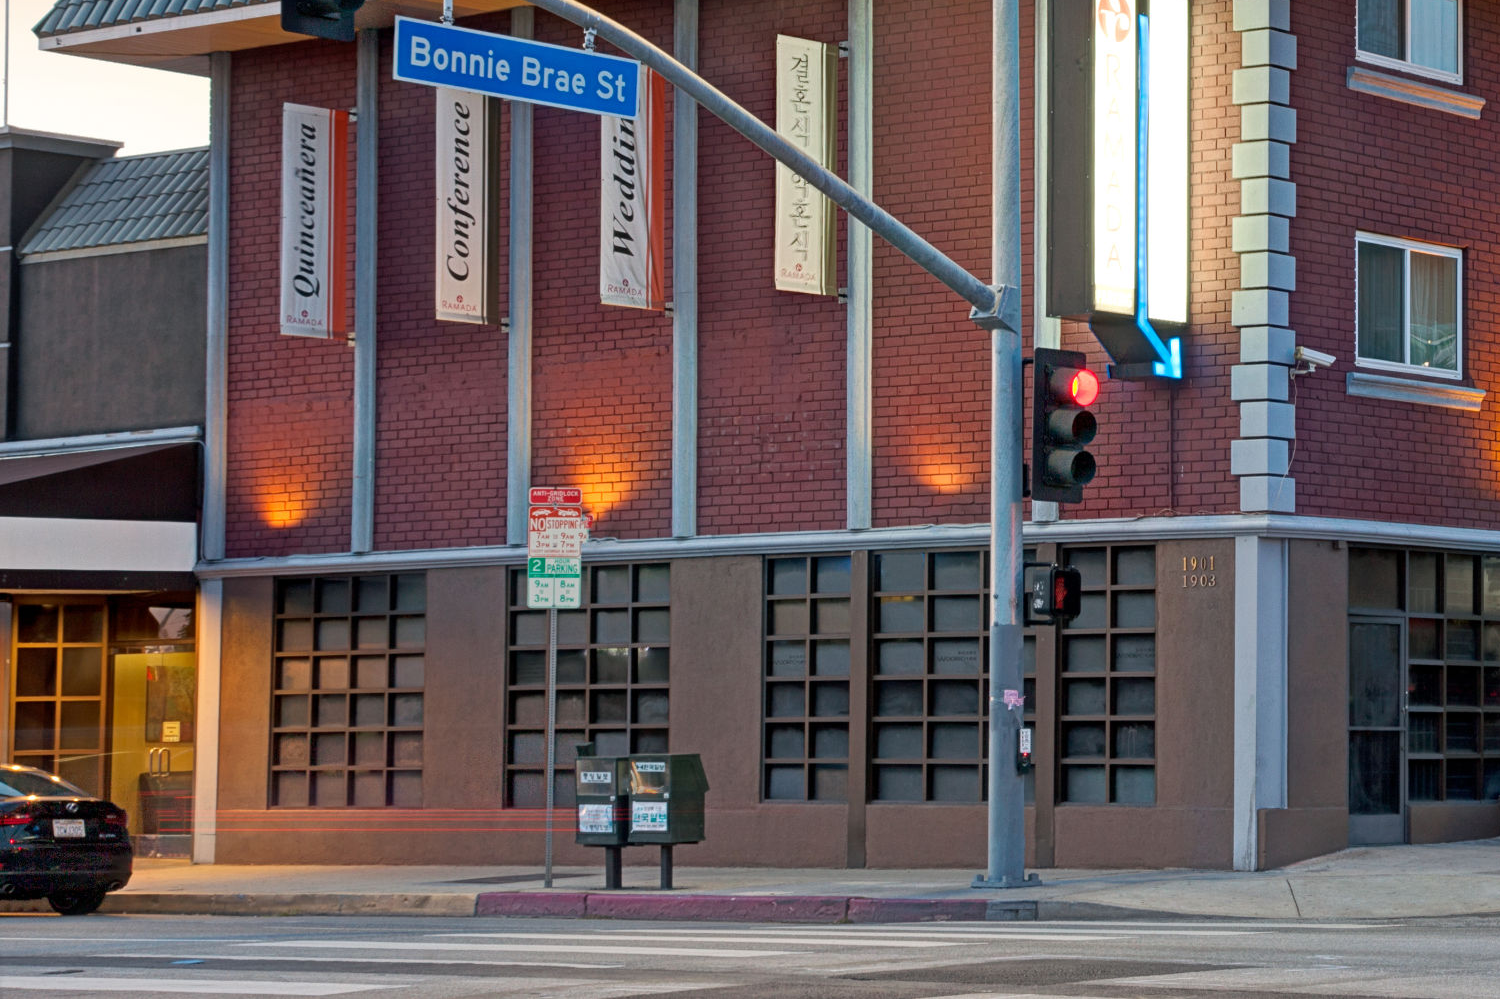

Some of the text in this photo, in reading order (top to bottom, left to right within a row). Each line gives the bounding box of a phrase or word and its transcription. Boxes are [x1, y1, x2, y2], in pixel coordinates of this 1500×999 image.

[410, 35, 626, 102] Bonnie Brae St
[1104, 53, 1125, 272] RAMADA
[446, 101, 476, 282] Conference
[612, 116, 635, 257] Weddin
[292, 122, 320, 298] Quinceañera
[607, 284, 642, 296] RAMADA
[441, 300, 477, 312] RAMADA
[286, 314, 323, 326] RAMADA
[530, 518, 546, 531] NO
[532, 559, 578, 574] 2 PARKING
[1183, 555, 1215, 571] 1901
[1182, 574, 1217, 588] 1903
